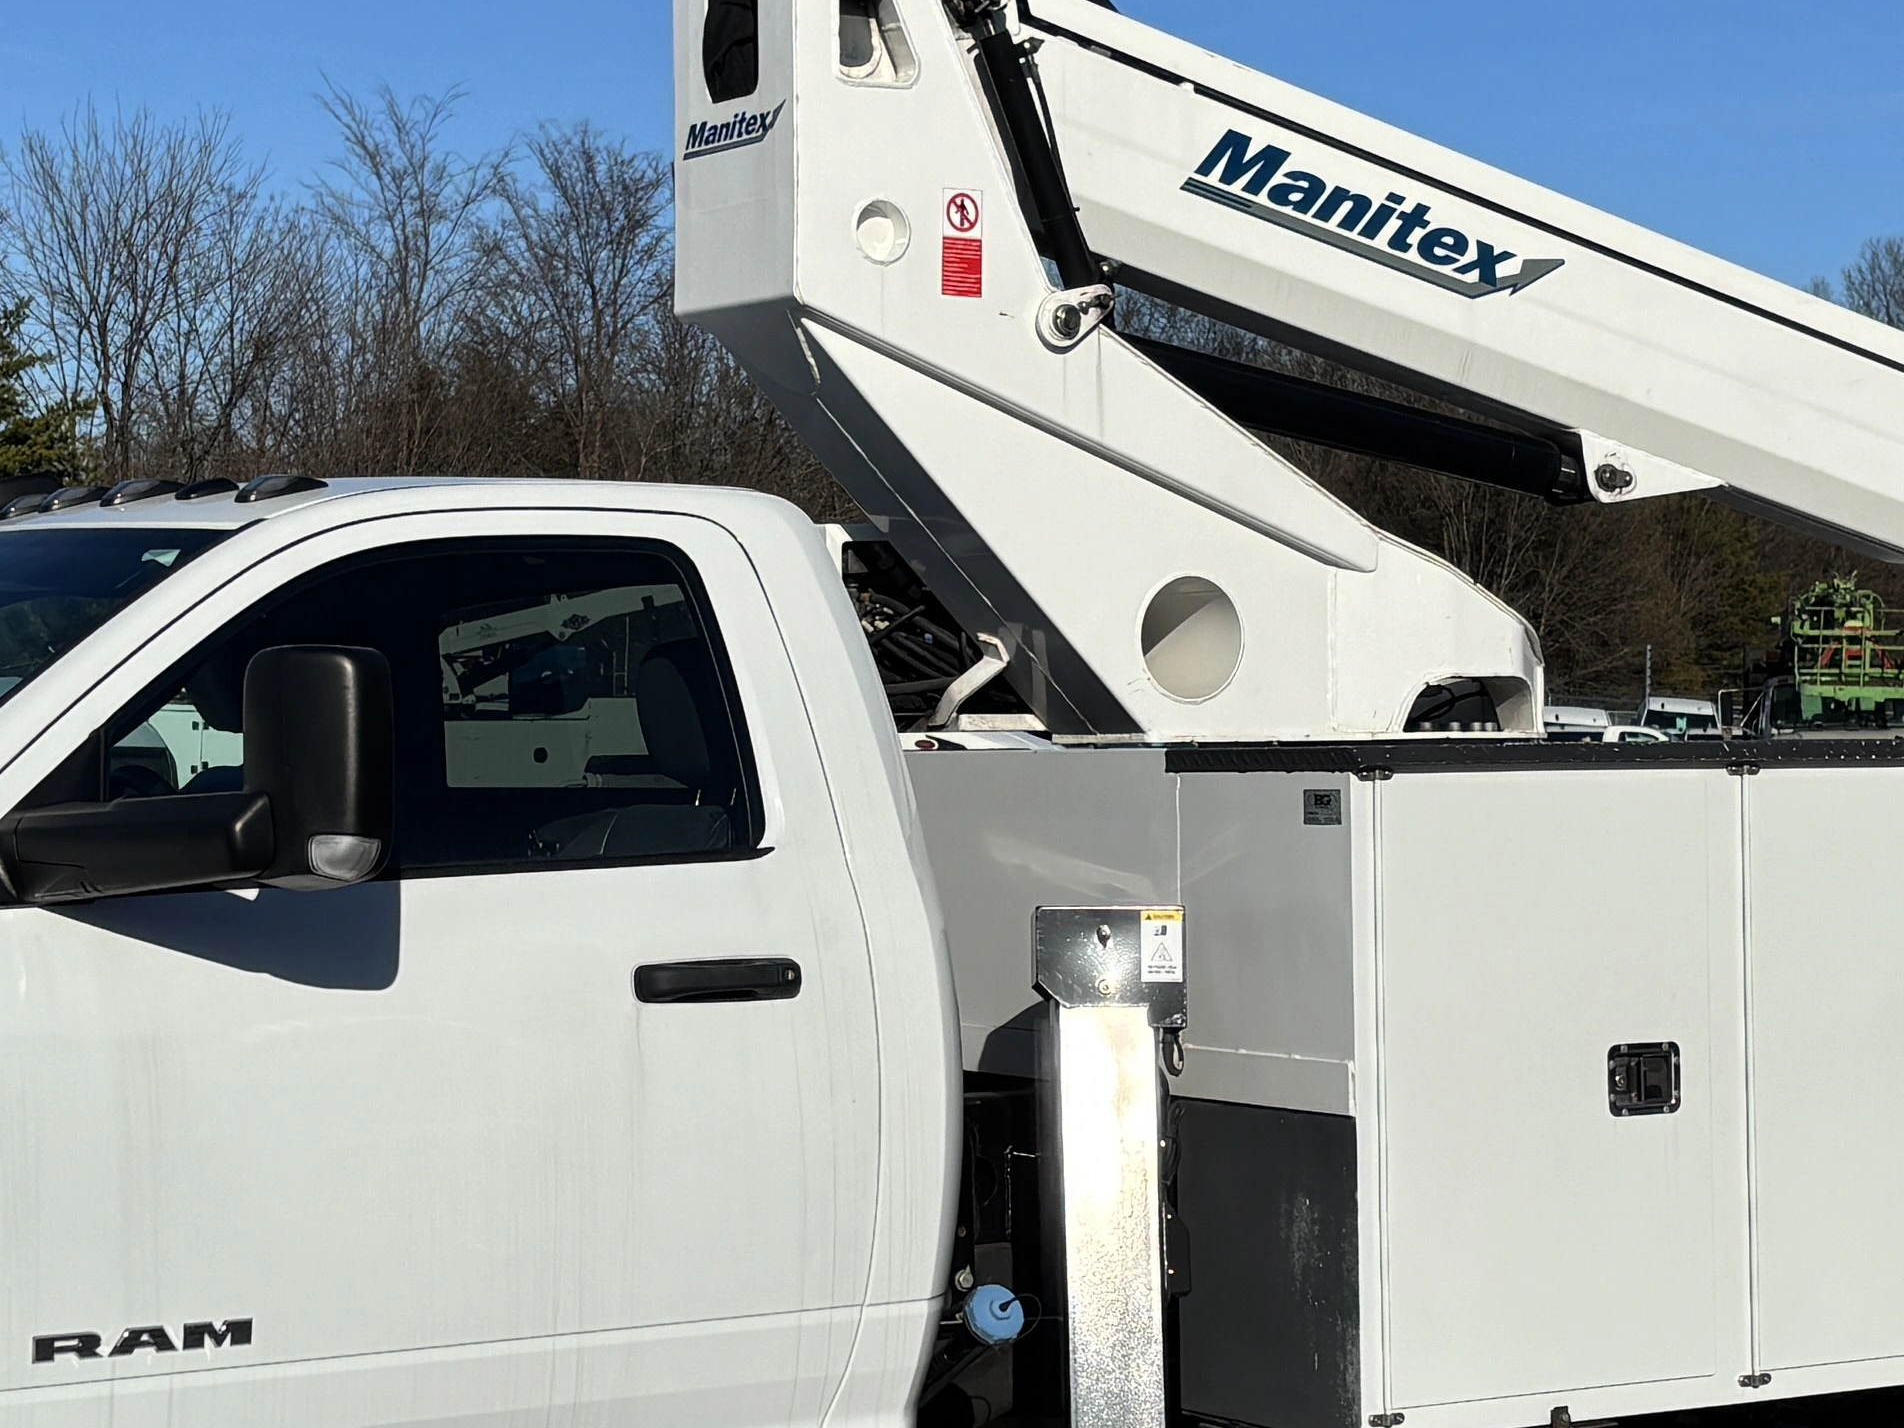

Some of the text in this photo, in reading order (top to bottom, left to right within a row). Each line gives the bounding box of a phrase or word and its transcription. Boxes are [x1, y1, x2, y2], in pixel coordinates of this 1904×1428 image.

[685, 110, 772, 151] Manitex
[1193, 128, 1517, 288] Manitex
[31, 1316, 254, 1364] RAM
